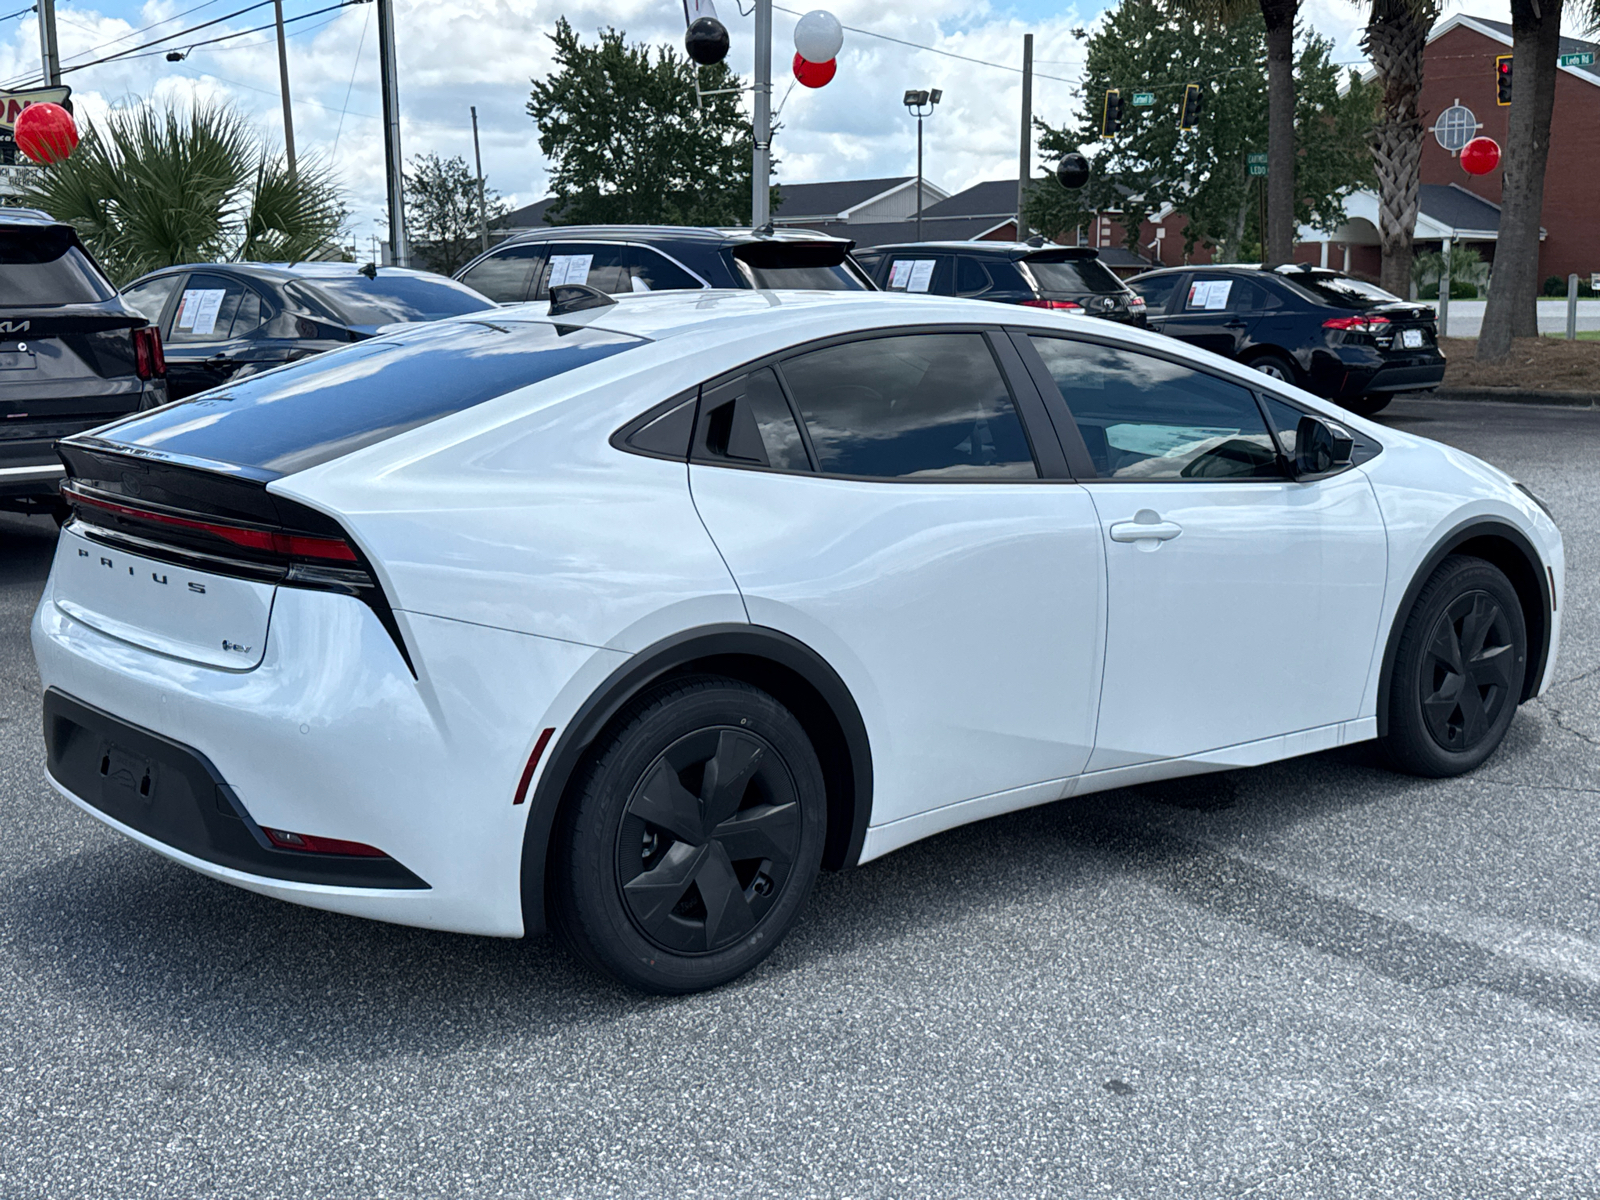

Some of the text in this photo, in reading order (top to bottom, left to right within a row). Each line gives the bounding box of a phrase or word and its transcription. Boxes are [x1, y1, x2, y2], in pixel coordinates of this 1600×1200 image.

[1565, 54, 1590, 65] Ledo Rd
[1250, 165, 1266, 175] LEDO
[78, 548, 206, 594] PRIUS
